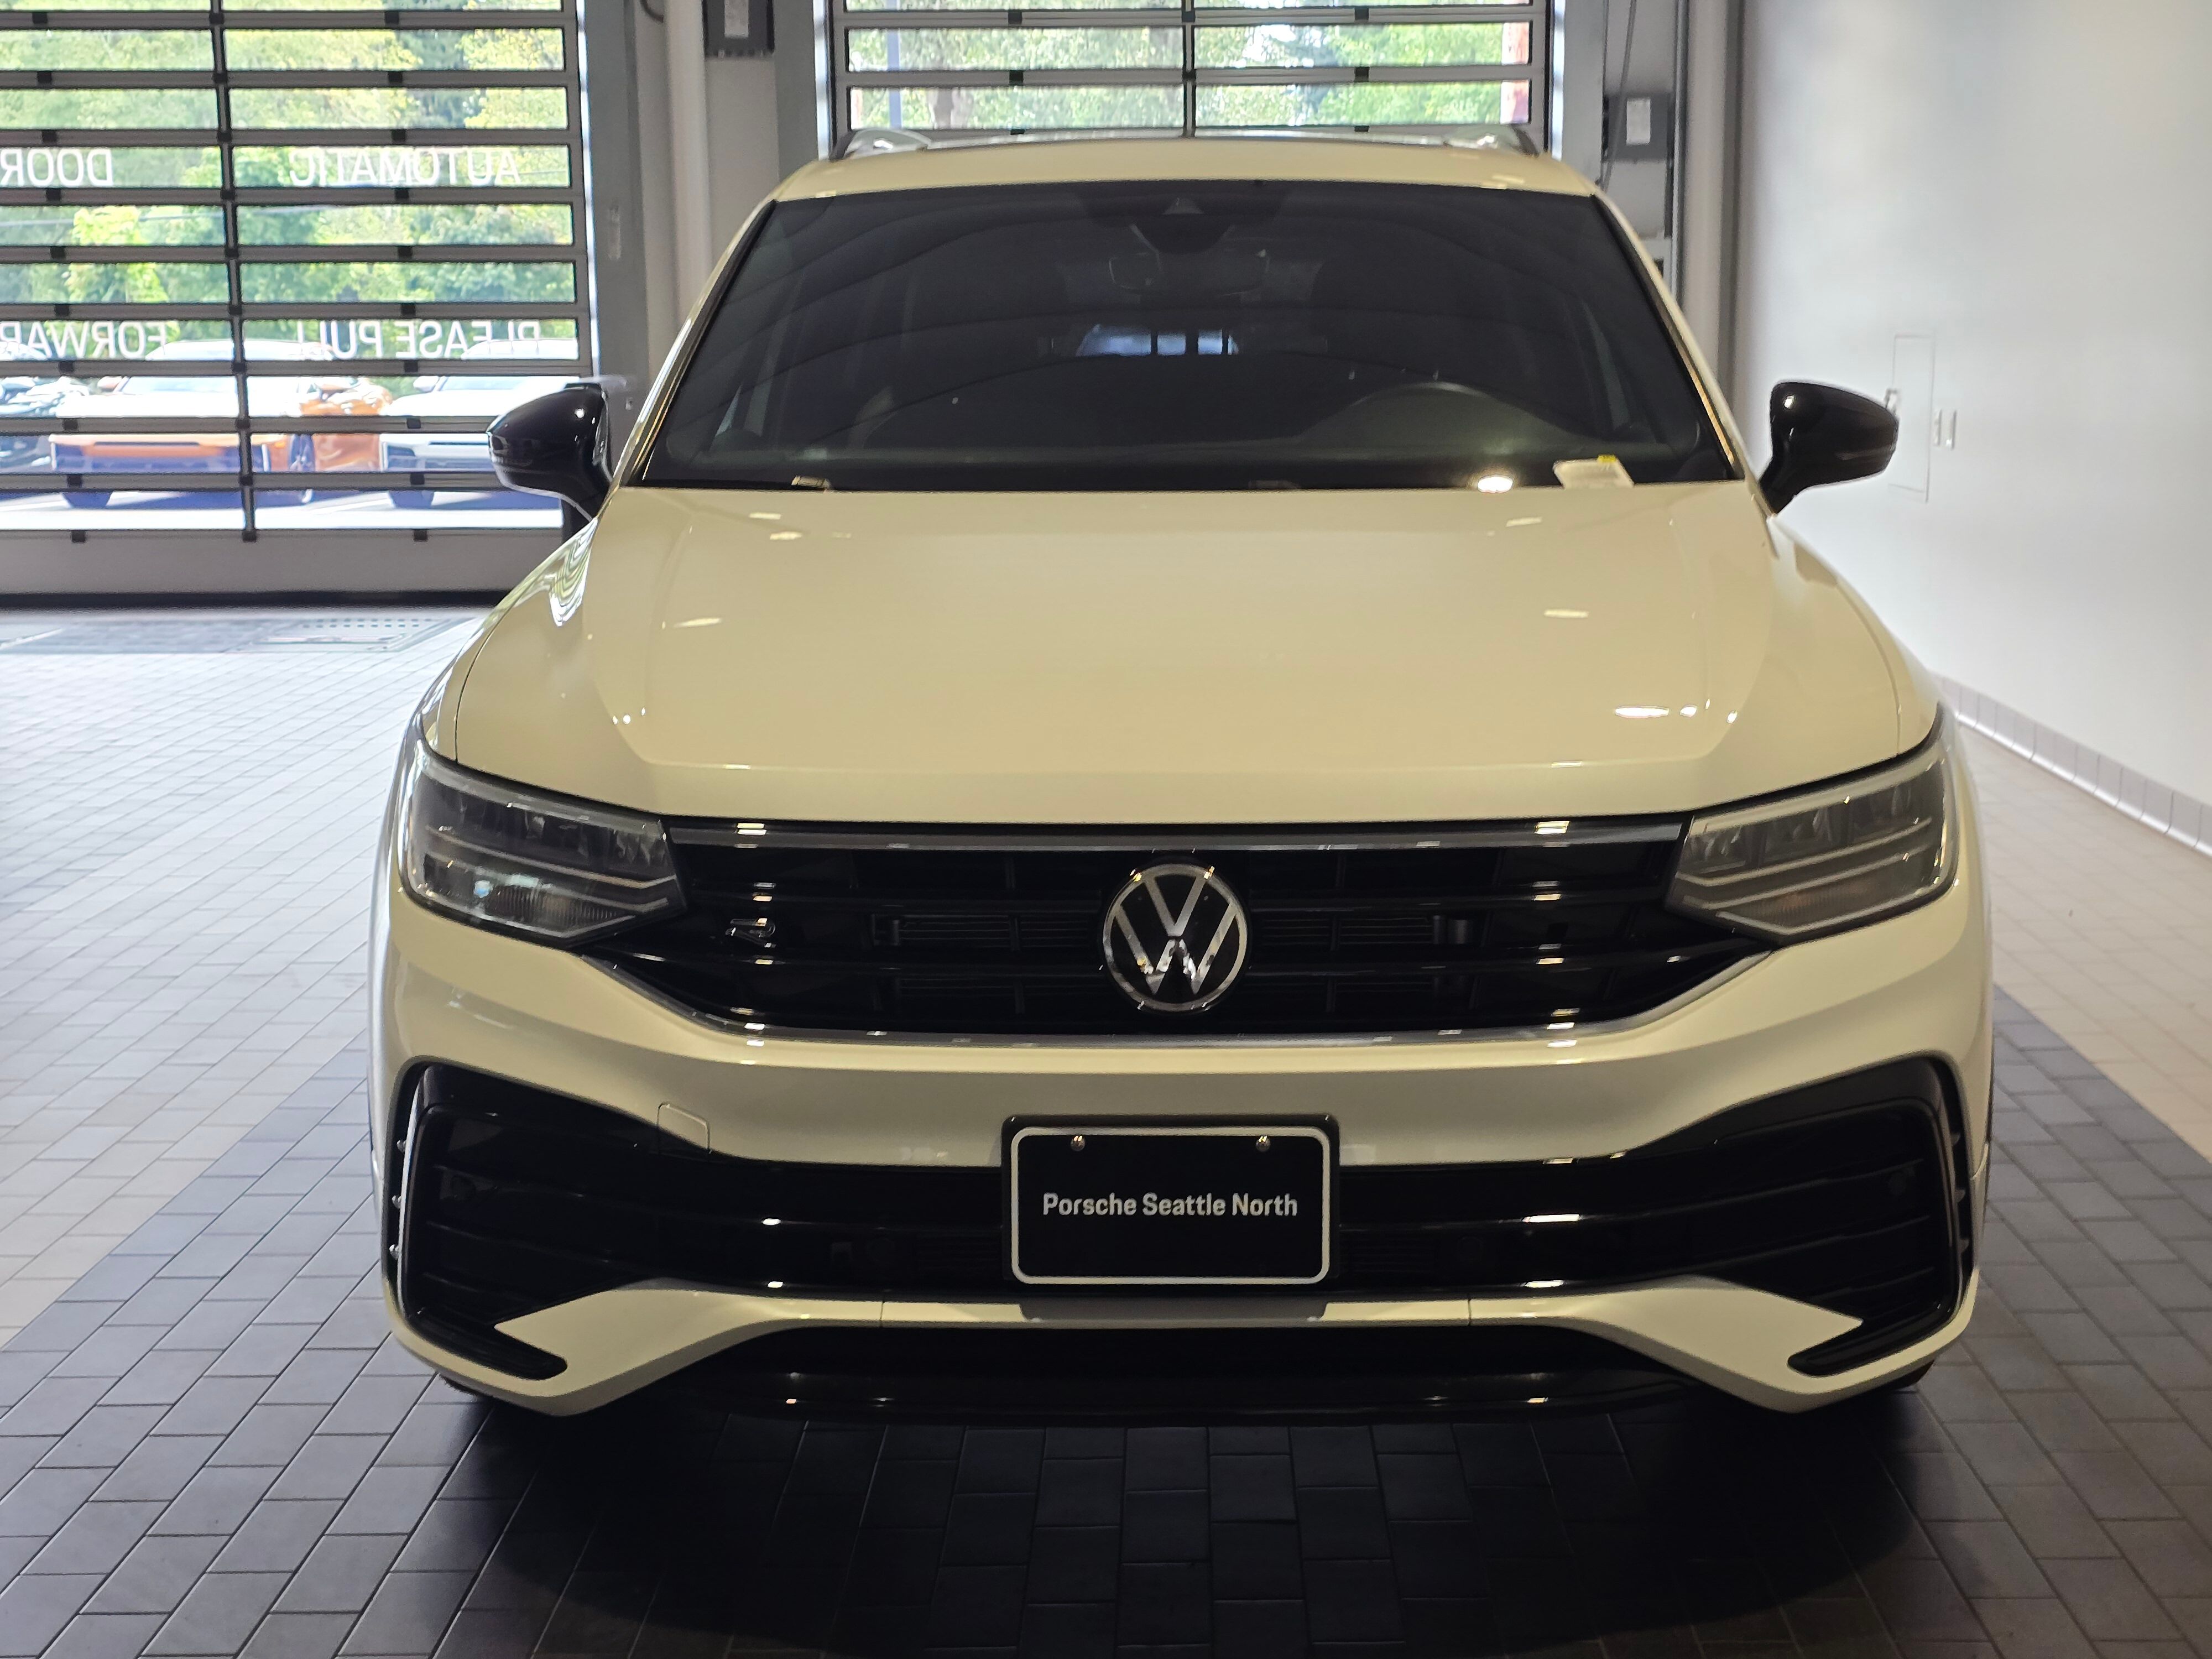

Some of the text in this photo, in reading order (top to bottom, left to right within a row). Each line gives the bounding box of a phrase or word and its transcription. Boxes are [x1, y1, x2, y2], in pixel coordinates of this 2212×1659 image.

[1108, 868, 1243, 1004] VW
[1042, 1192, 1298, 1217] Porsche Seattle North
